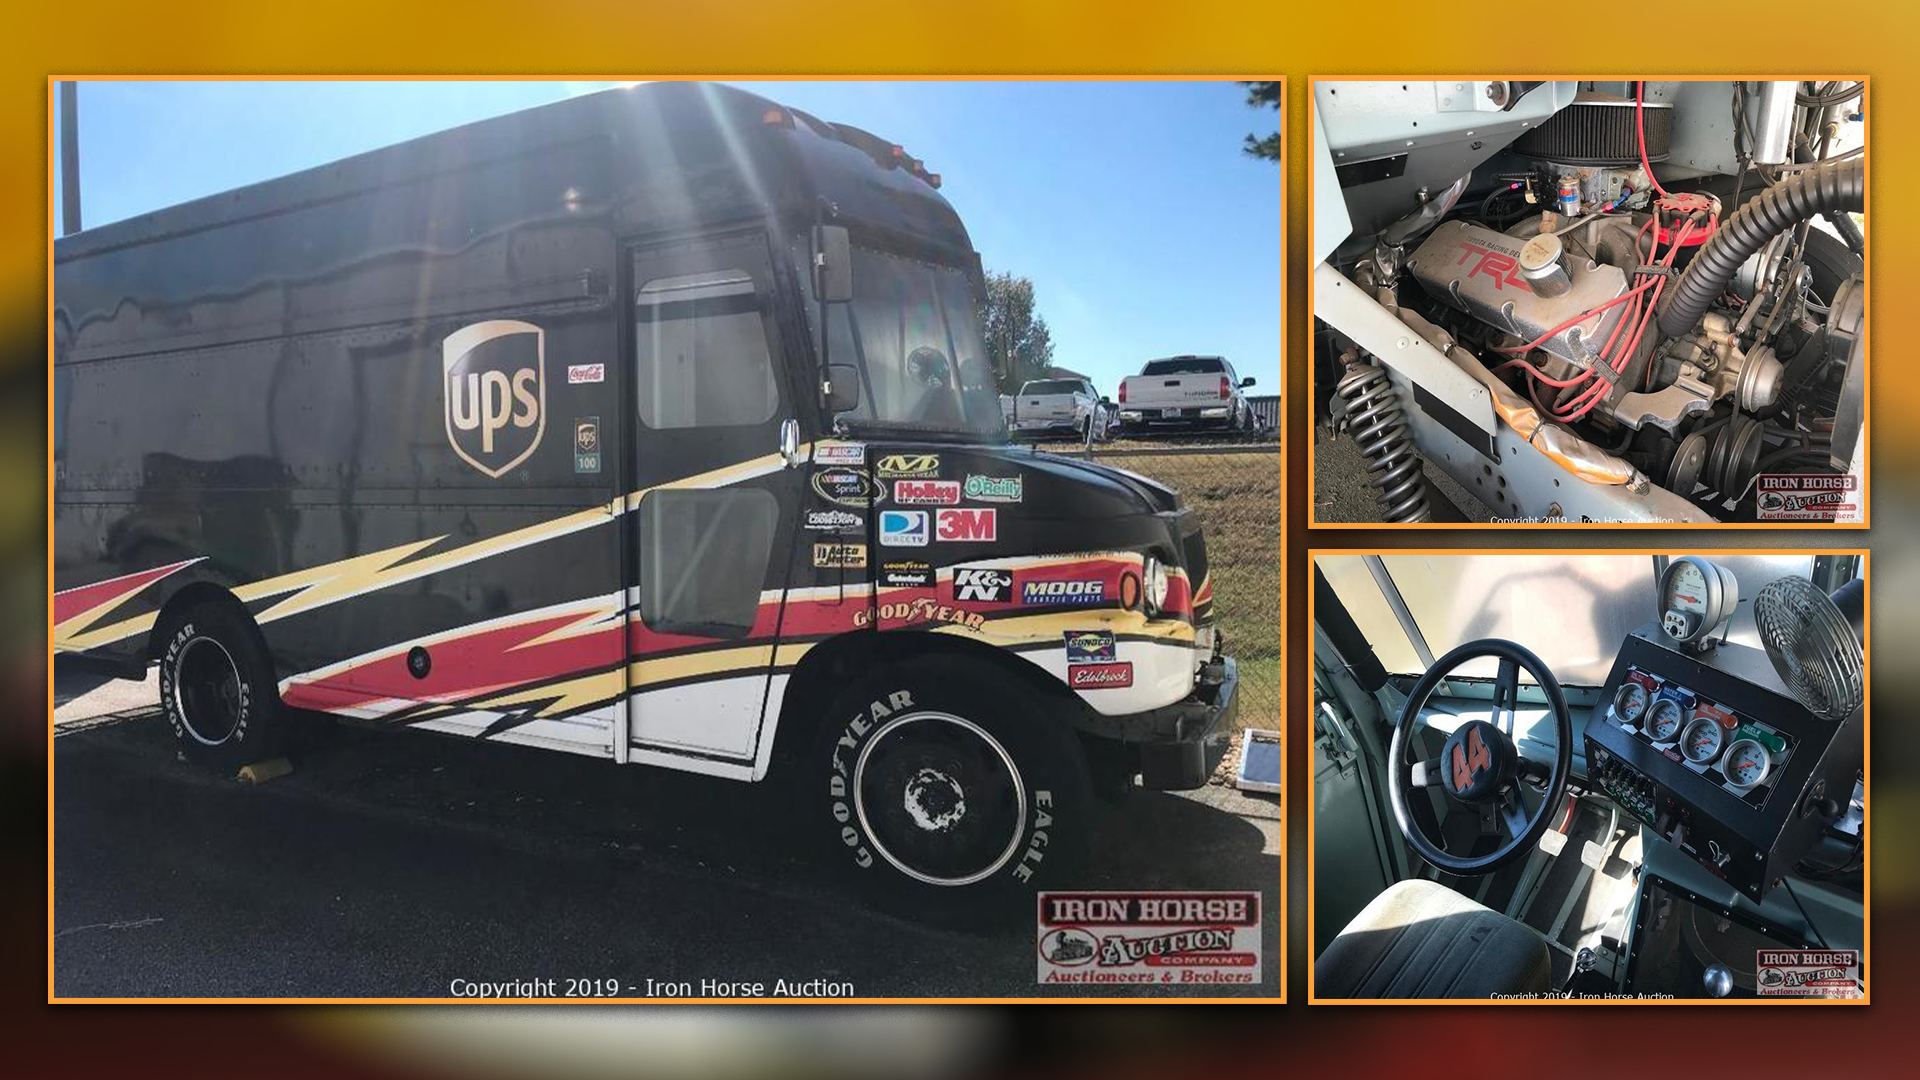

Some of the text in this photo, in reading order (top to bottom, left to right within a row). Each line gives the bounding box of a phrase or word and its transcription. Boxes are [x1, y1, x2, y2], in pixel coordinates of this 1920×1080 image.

[1465, 235, 1487, 247] TOYOTA
[1486, 241, 1509, 254] RACING
[452, 367, 539, 452] ups
[580, 431, 596, 445] ups
[579, 457, 597, 469] 100
[835, 484, 861, 495] Sprint
[898, 482, 957, 503] Holley
[938, 510, 994, 539] 3M
[883, 536, 924, 544] DIRECTV
[829, 546, 860, 555] Auto
[1025, 581, 1103, 596] MOOG
[853, 598, 985, 628] GOODYEAR
[1068, 637, 1113, 648] SUNOCO
[1075, 669, 1128, 684] Edelbrock
[1453, 724, 1491, 792] 44
[830, 690, 915, 868] GOODYEAR
[1012, 790, 1053, 883] EAGLE
